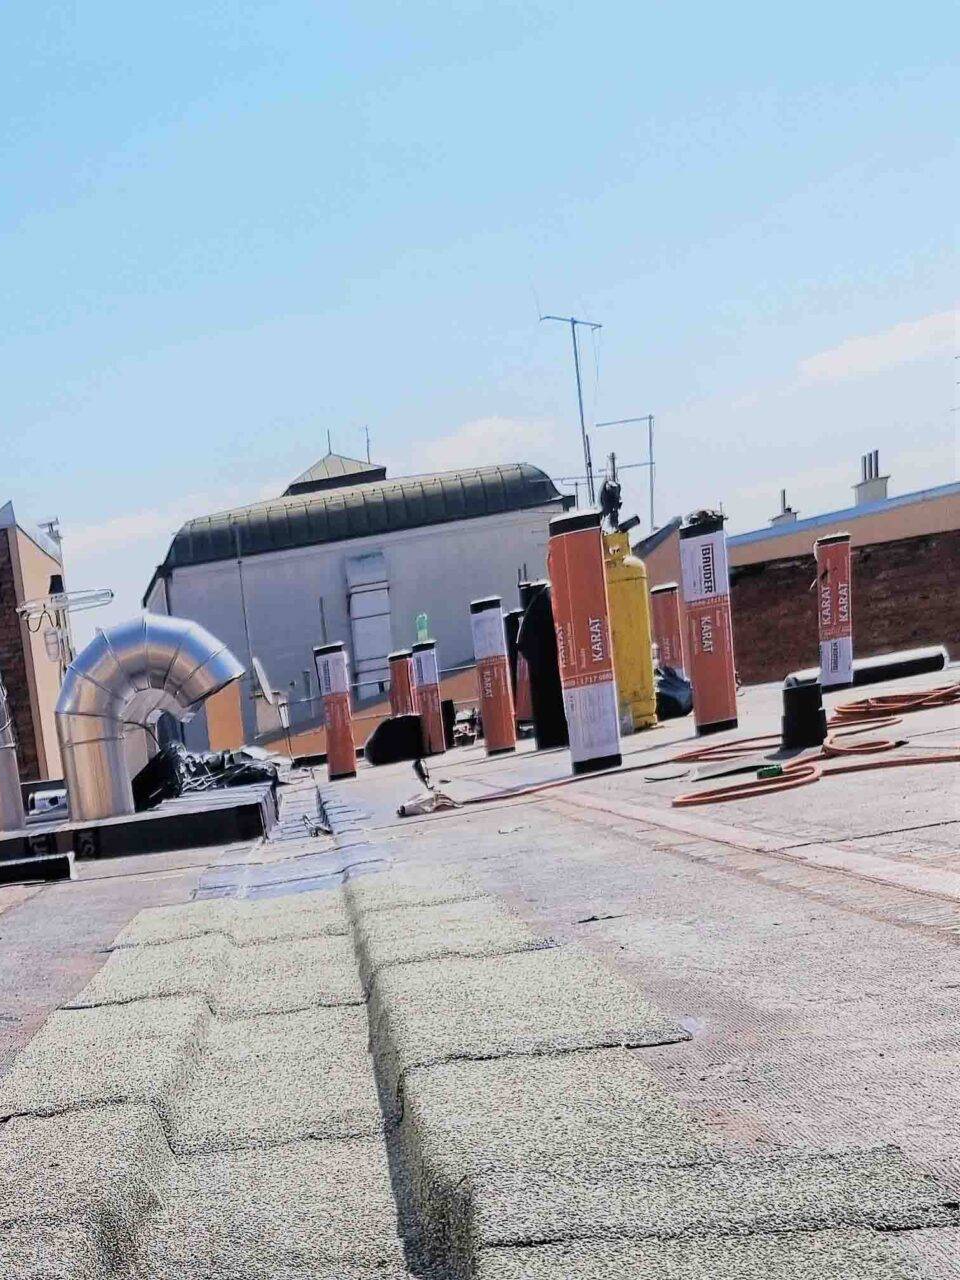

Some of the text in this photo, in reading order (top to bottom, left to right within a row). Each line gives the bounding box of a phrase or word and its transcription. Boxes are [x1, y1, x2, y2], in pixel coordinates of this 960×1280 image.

[700, 546, 715, 594] BAUDER
[821, 585, 832, 625] KARAT
[589, 617, 604, 663] KARAT
[700, 616, 713, 654] KARAT
